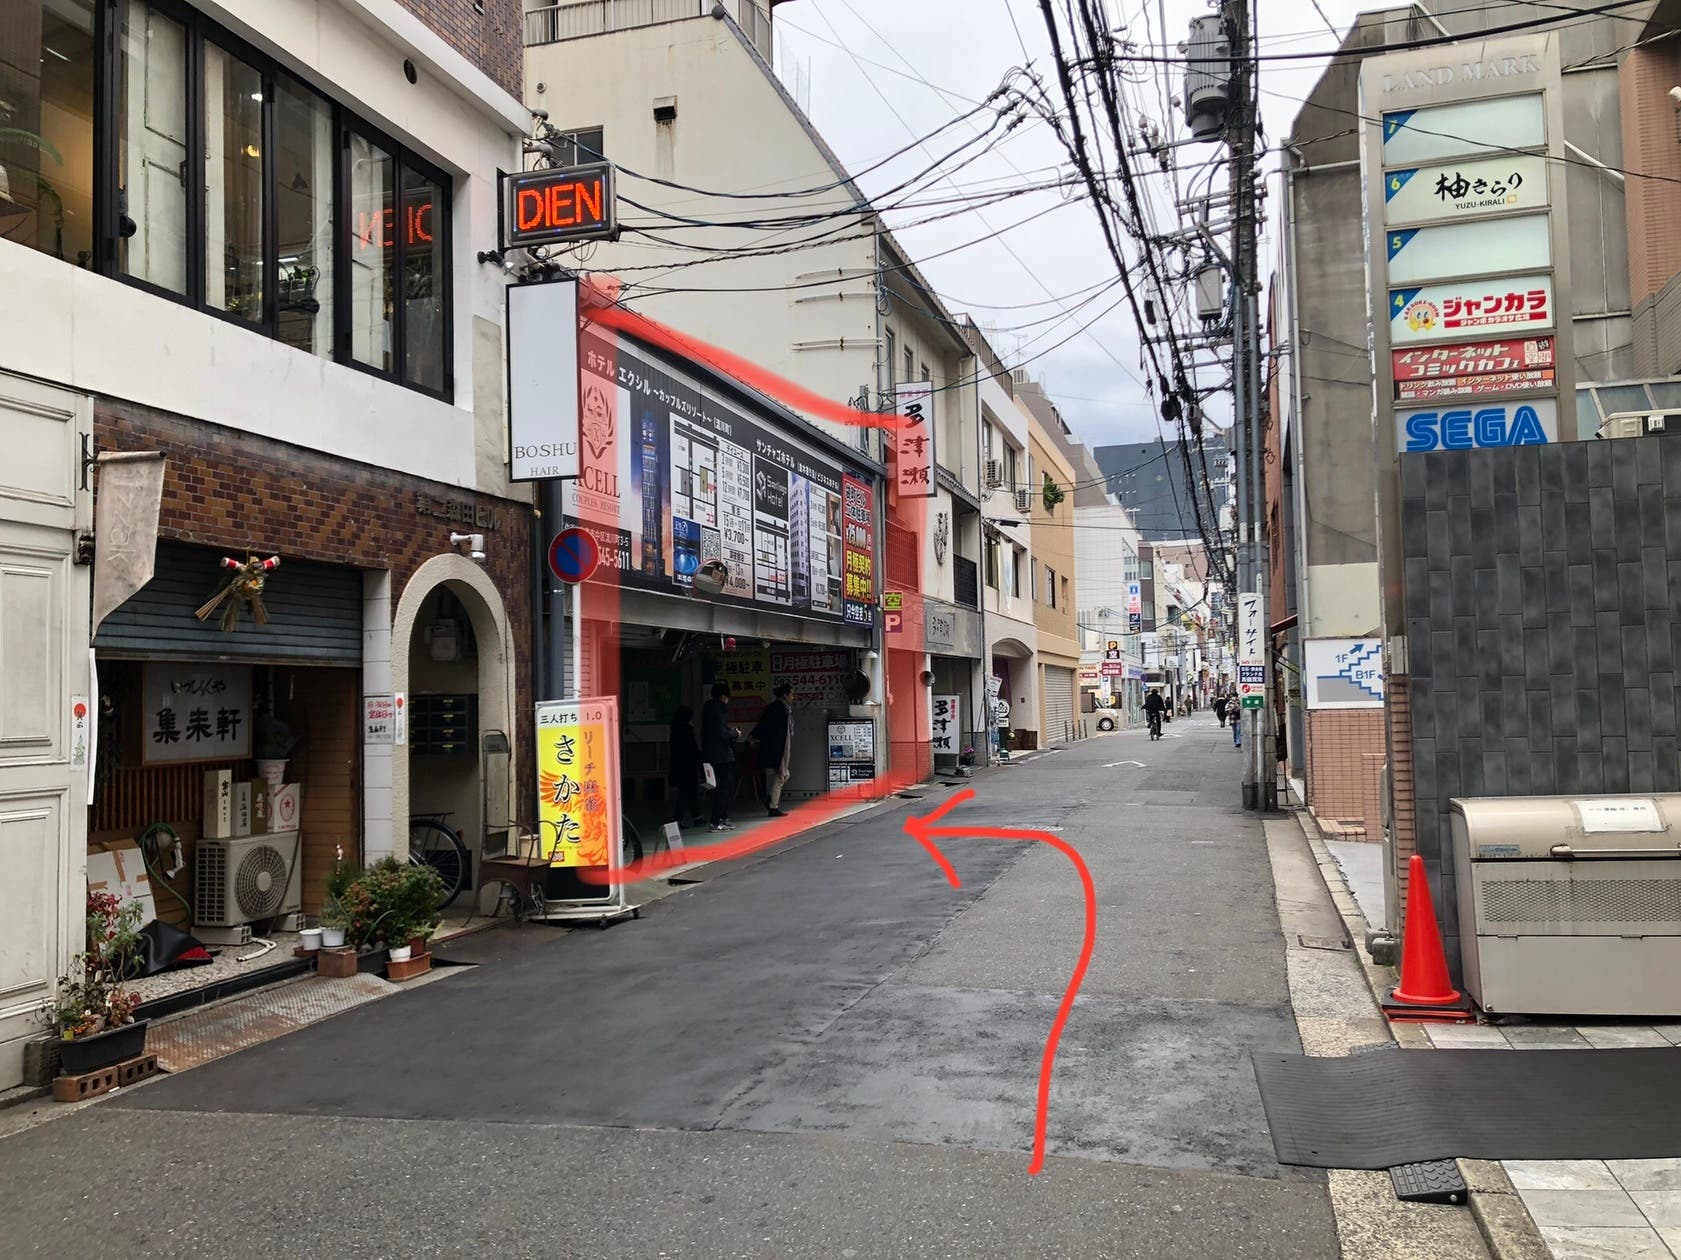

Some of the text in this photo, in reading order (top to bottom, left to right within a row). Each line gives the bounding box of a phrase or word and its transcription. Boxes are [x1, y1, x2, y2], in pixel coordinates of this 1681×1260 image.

[1384, 54, 1540, 93] LAND MARK
[1388, 119, 1398, 134] 7
[1391, 177, 1401, 191] 6
[518, 180, 601, 230] DIEN
[1455, 199, 1505, 210] YUZU-KIRALI
[1392, 236, 1402, 249] 5
[1394, 294, 1404, 307] 4
[1443, 289, 1547, 318] ジャンカラ
[1399, 343, 1509, 364] インターネット
[588, 350, 614, 377] ホテル
[619, 367, 651, 396] エクシル
[1410, 358, 1520, 377] コミックカフェ
[1405, 405, 1549, 453] SEGA
[514, 441, 577, 460] BOSHU
[530, 465, 560, 477] HAIR
[885, 614, 901, 632] P
[1335, 653, 1349, 663] 1F
[1355, 670, 1376, 680] B1F
[540, 712, 578, 724] 三人打ち
[583, 731, 600, 813] リーチ麻雀
[553, 734, 581, 844] さかた
